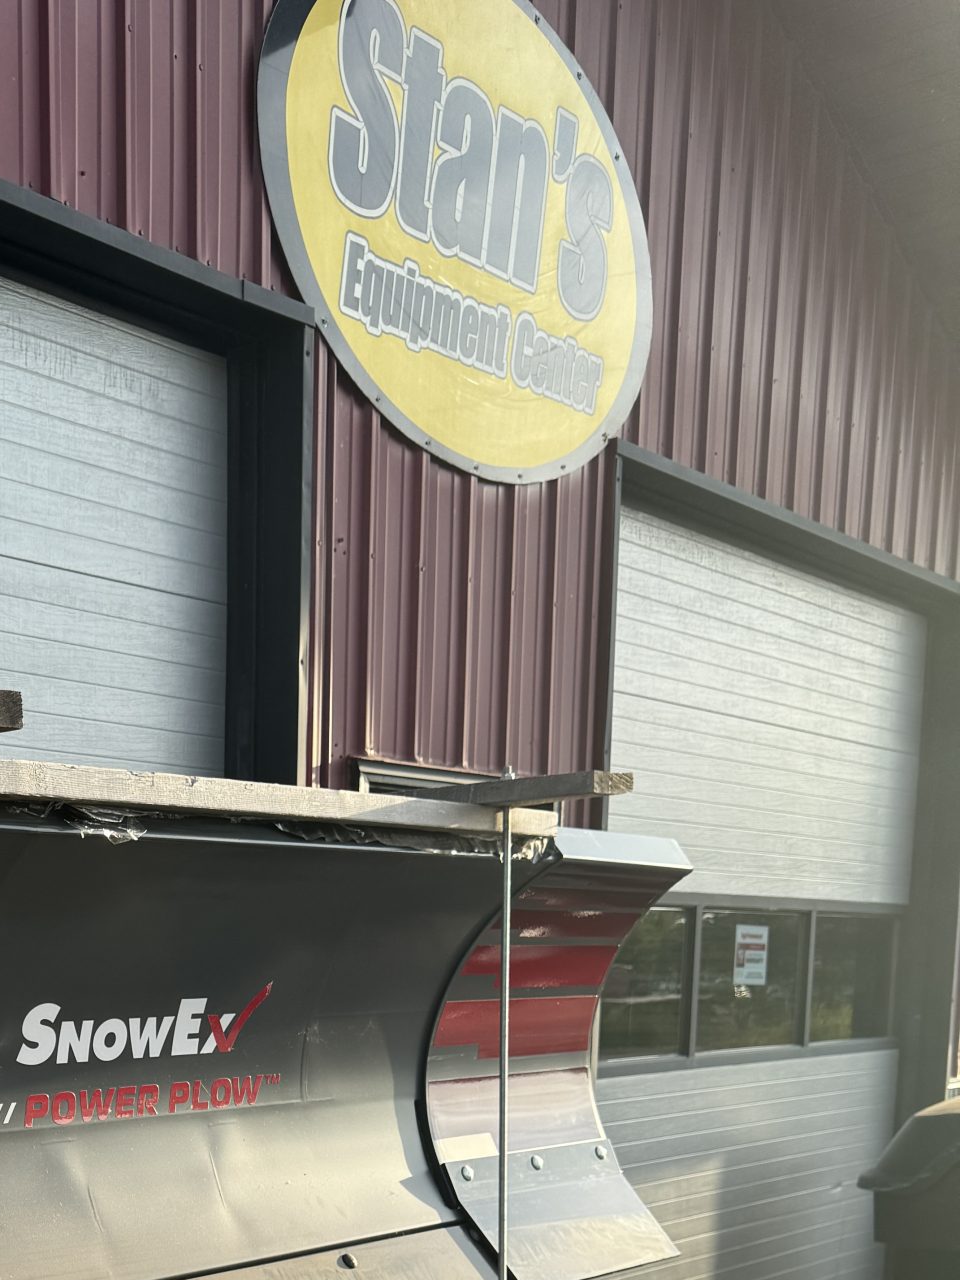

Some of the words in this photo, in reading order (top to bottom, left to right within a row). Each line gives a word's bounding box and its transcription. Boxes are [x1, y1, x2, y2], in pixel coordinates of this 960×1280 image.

[328, 0, 614, 321] Stan's
[340, 230, 511, 380] Equipment
[511, 311, 604, 416] Center
[23, 1083, 160, 1129] POWER
